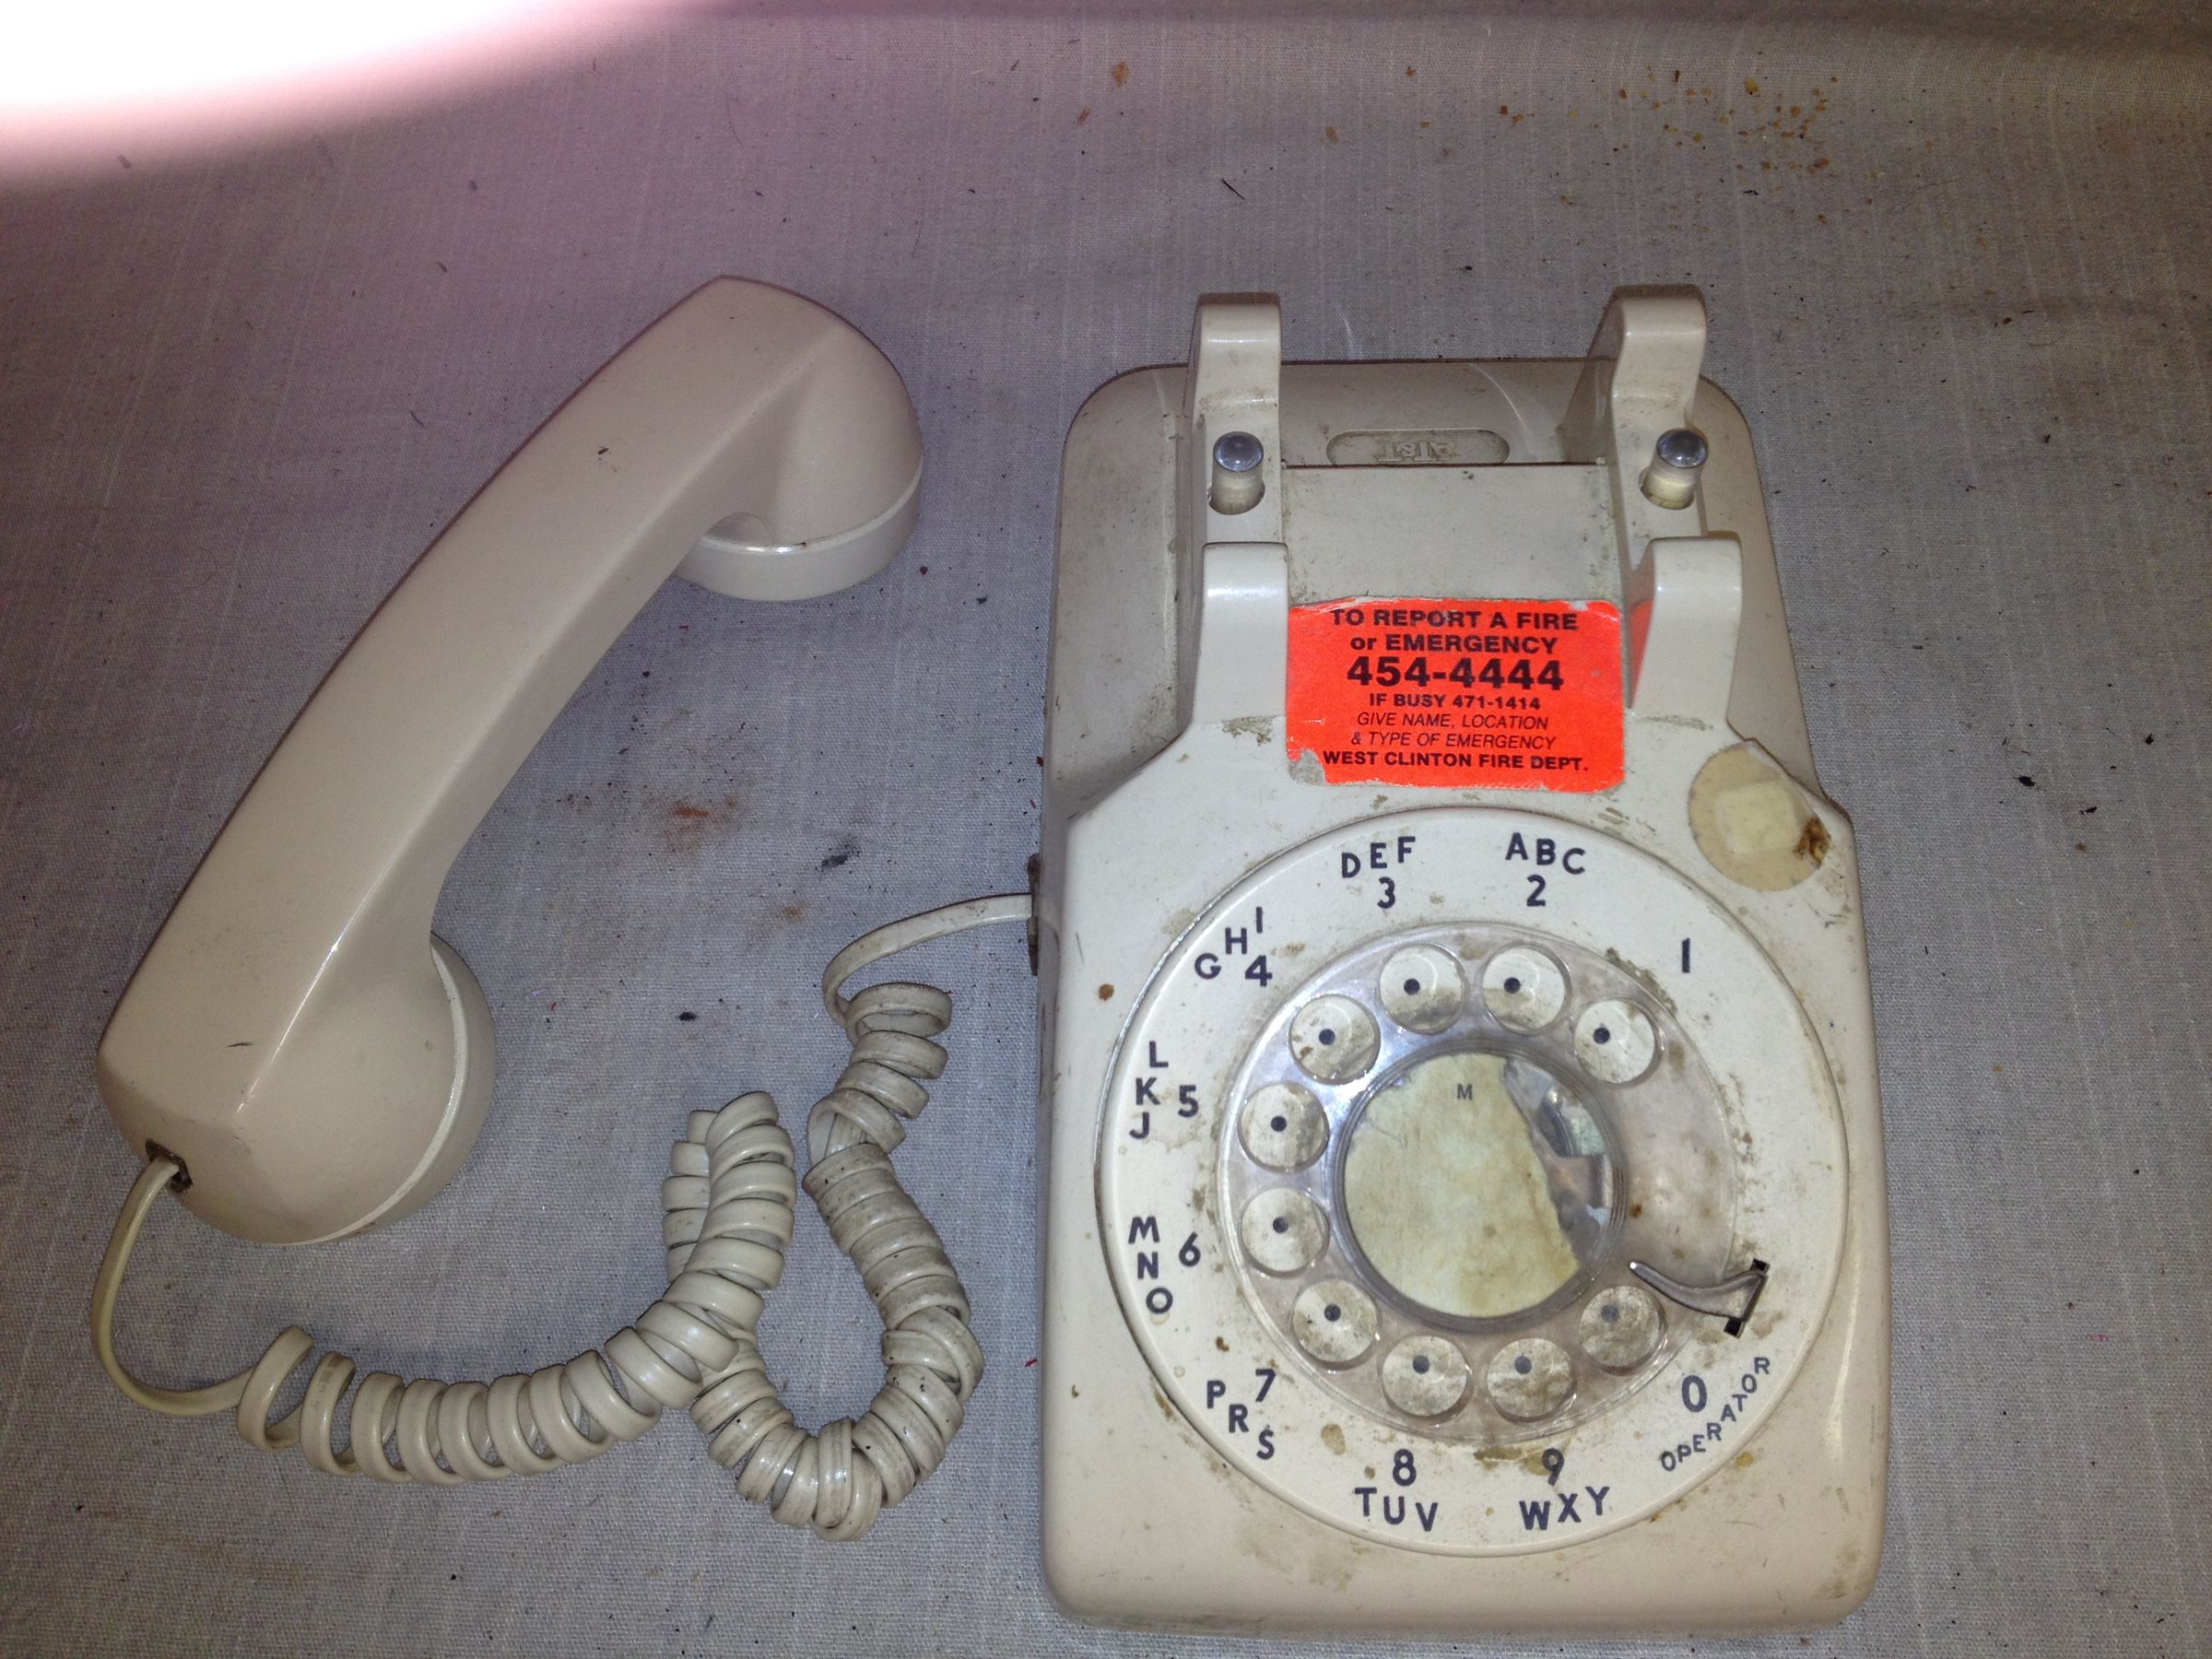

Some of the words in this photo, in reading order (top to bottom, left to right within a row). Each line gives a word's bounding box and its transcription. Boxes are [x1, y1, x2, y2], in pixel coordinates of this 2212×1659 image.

[1330, 609, 1365, 627] TO
[1373, 609, 1484, 628] REPORT
[1489, 612, 1508, 629] A
[1516, 612, 1578, 630] FIRE
[1350, 636, 1377, 651] or
[1385, 633, 1558, 654] EMERGENCY
[1347, 655, 1564, 690] 454-4444
[1370, 693, 1387, 706] IF
[1394, 693, 1445, 707] BUSY
[1453, 695, 1541, 710] 471-1414
[1357, 712, 1396, 726] GIVE
[1403, 712, 1454, 728] NAME,
[1462, 714, 1548, 730] LOCATION
[1350, 732, 1361, 746] &
[1369, 732, 1413, 747] TYPE
[1417, 733, 1439, 747] OF
[1445, 735, 1556, 750] EMERGENCY
[1323, 750, 1379, 765] WEST
[1384, 751, 1472, 767] CLINTON
[1478, 753, 1524, 768] FIRE
[1530, 756, 1589, 771] DEPT.
[1341, 836, 1416, 878] DEF
[1505, 832, 1585, 875] ABC
[1377, 877, 1396, 909] 3
[1526, 874, 1547, 907] 2
[1244, 955, 1273, 987] 4
[1177, 1085, 1199, 1118] 5
[1457, 1084, 1473, 1100] M
[1178, 1232, 1201, 1267] 6
[1255, 1369, 1276, 1402] 7
[1681, 1375, 1707, 1413] 0
[1660, 1357, 1771, 1472] OPERATOR
[1392, 1449, 1417, 1487] 8
[1542, 1448, 1565, 1486] 9
[1354, 1487, 1438, 1532] TUV
[1519, 1486, 1610, 1531] WXY
